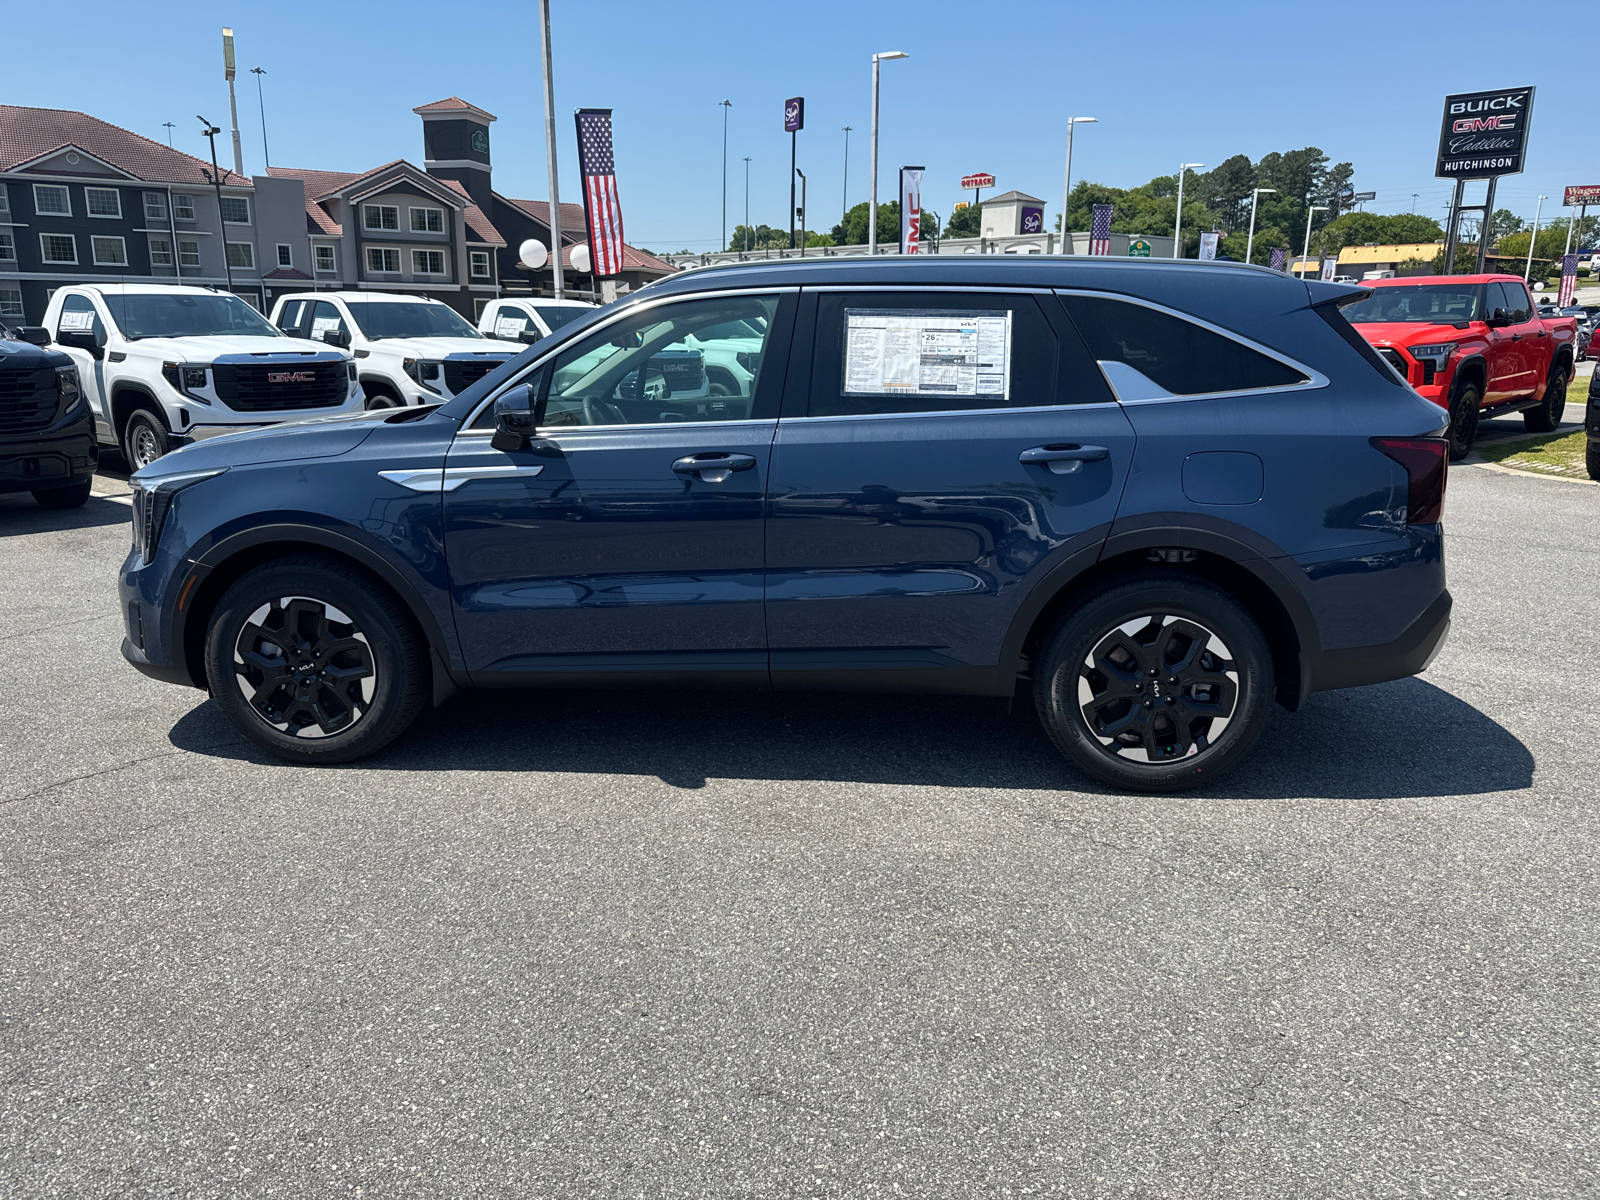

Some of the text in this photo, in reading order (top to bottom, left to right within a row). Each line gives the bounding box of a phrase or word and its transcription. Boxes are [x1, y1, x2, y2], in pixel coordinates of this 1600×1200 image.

[1450, 95, 1523, 114] BUICK
[1452, 113, 1516, 133] GMC
[1449, 134, 1514, 154] Cadillac
[1445, 158, 1512, 171] HUTCHINSON
[961, 177, 992, 188] OUTBACK
[268, 371, 315, 382] GMC
[299, 662, 315, 671] KIA
